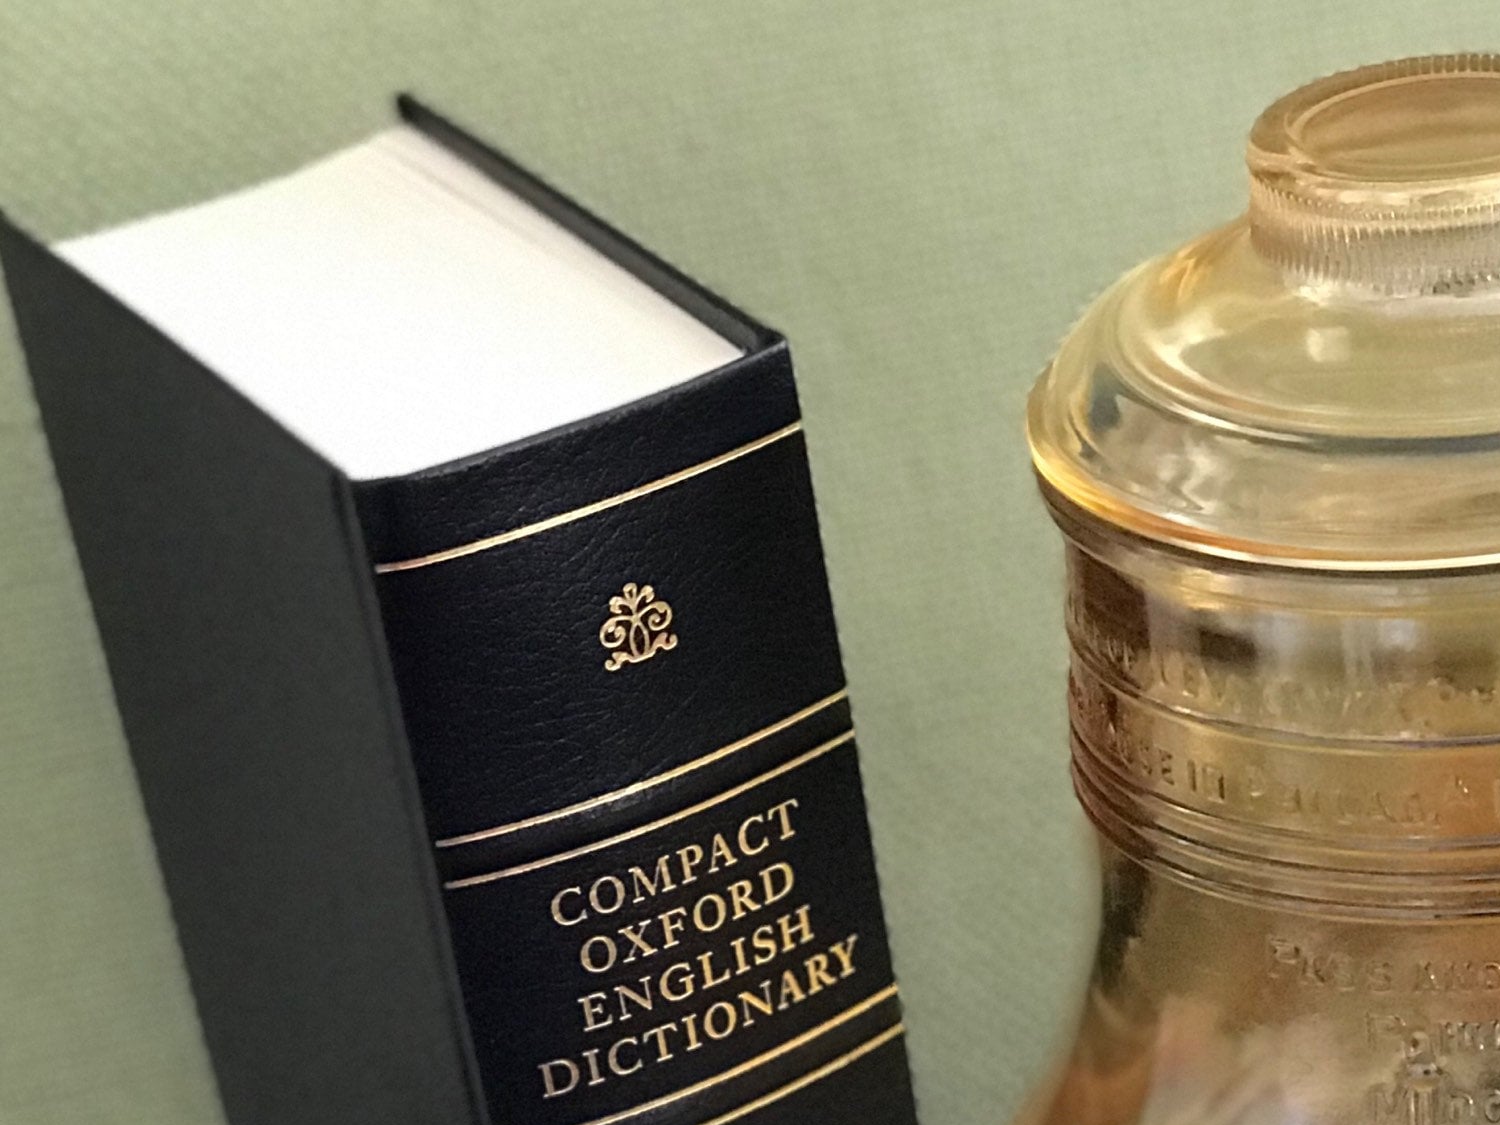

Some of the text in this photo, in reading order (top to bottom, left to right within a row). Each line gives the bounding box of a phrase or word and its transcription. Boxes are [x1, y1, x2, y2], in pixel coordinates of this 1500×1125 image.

[551, 799, 799, 926] COMPACT
[580, 862, 796, 973] OXFORD
[538, 934, 858, 1098] DICTIONARY
[578, 905, 812, 1031] ENGLISH
